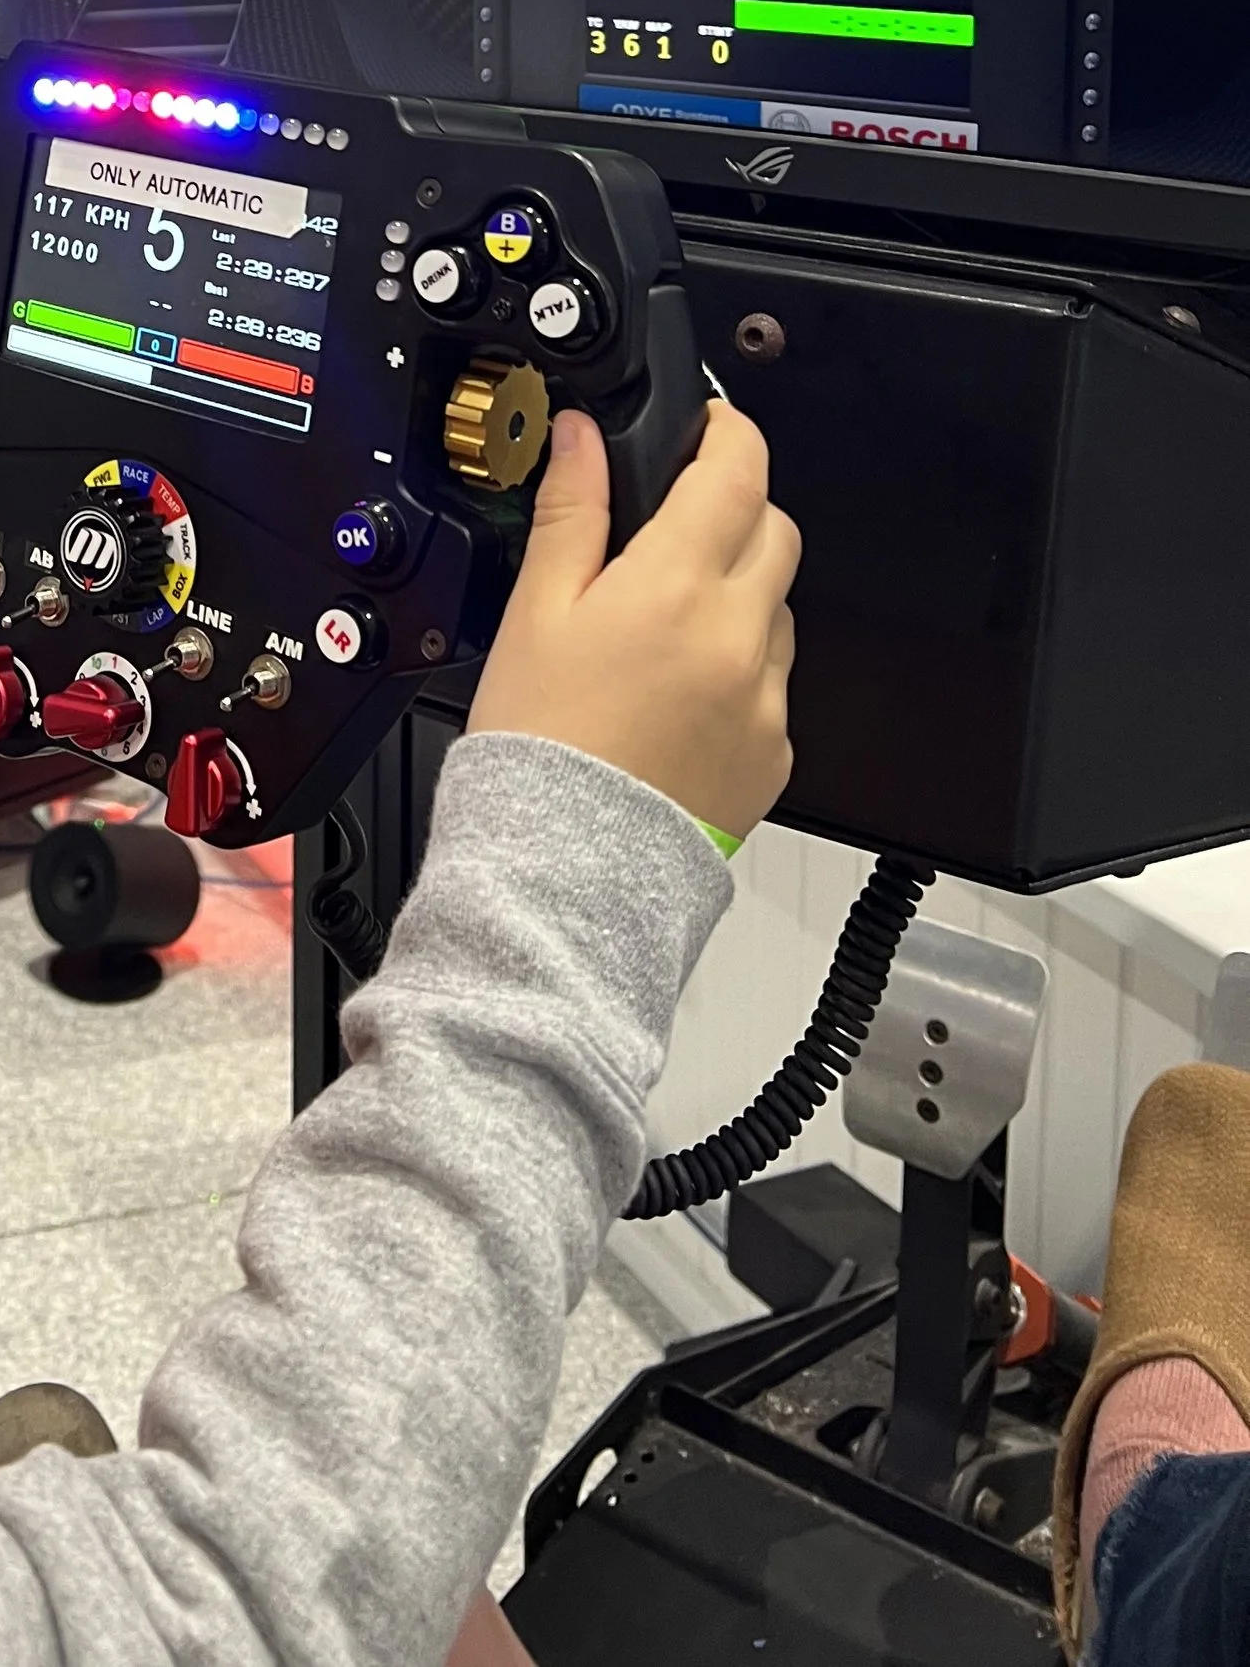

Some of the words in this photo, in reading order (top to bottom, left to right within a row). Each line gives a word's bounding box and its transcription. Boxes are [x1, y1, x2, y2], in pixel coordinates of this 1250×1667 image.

[589, 30, 606, 54] 3
[623, 32, 641, 57] 6
[656, 35, 672, 59] 1
[711, 39, 730, 64] 0
[91, 162, 141, 188] ONLY
[146, 174, 263, 215] AUTOMATIC
[33, 192, 74, 218] 117
[85, 202, 131, 231] KPH
[501, 213, 515, 232] B
[31, 230, 99, 263] 12000
[143, 207, 185, 272] 5
[216, 252, 330, 291] 2:29:297
[421, 263, 452, 290] DRINK
[12, 301, 27, 318] G
[534, 298, 575, 321] TALK
[207, 308, 322, 352] 2:28:236
[122, 465, 149, 483] RACE
[158, 484, 181, 513] TEMP
[179, 523, 192, 560] TRACK
[337, 527, 369, 549] OK
[172, 573, 187, 599] BOX
[147, 607, 164, 625] LAP
[187, 600, 233, 633] LINE
[265, 632, 303, 661] A/M
[324, 619, 351, 655] LR
[112, 656, 118, 669] 1
[130, 671, 138, 686] 2
